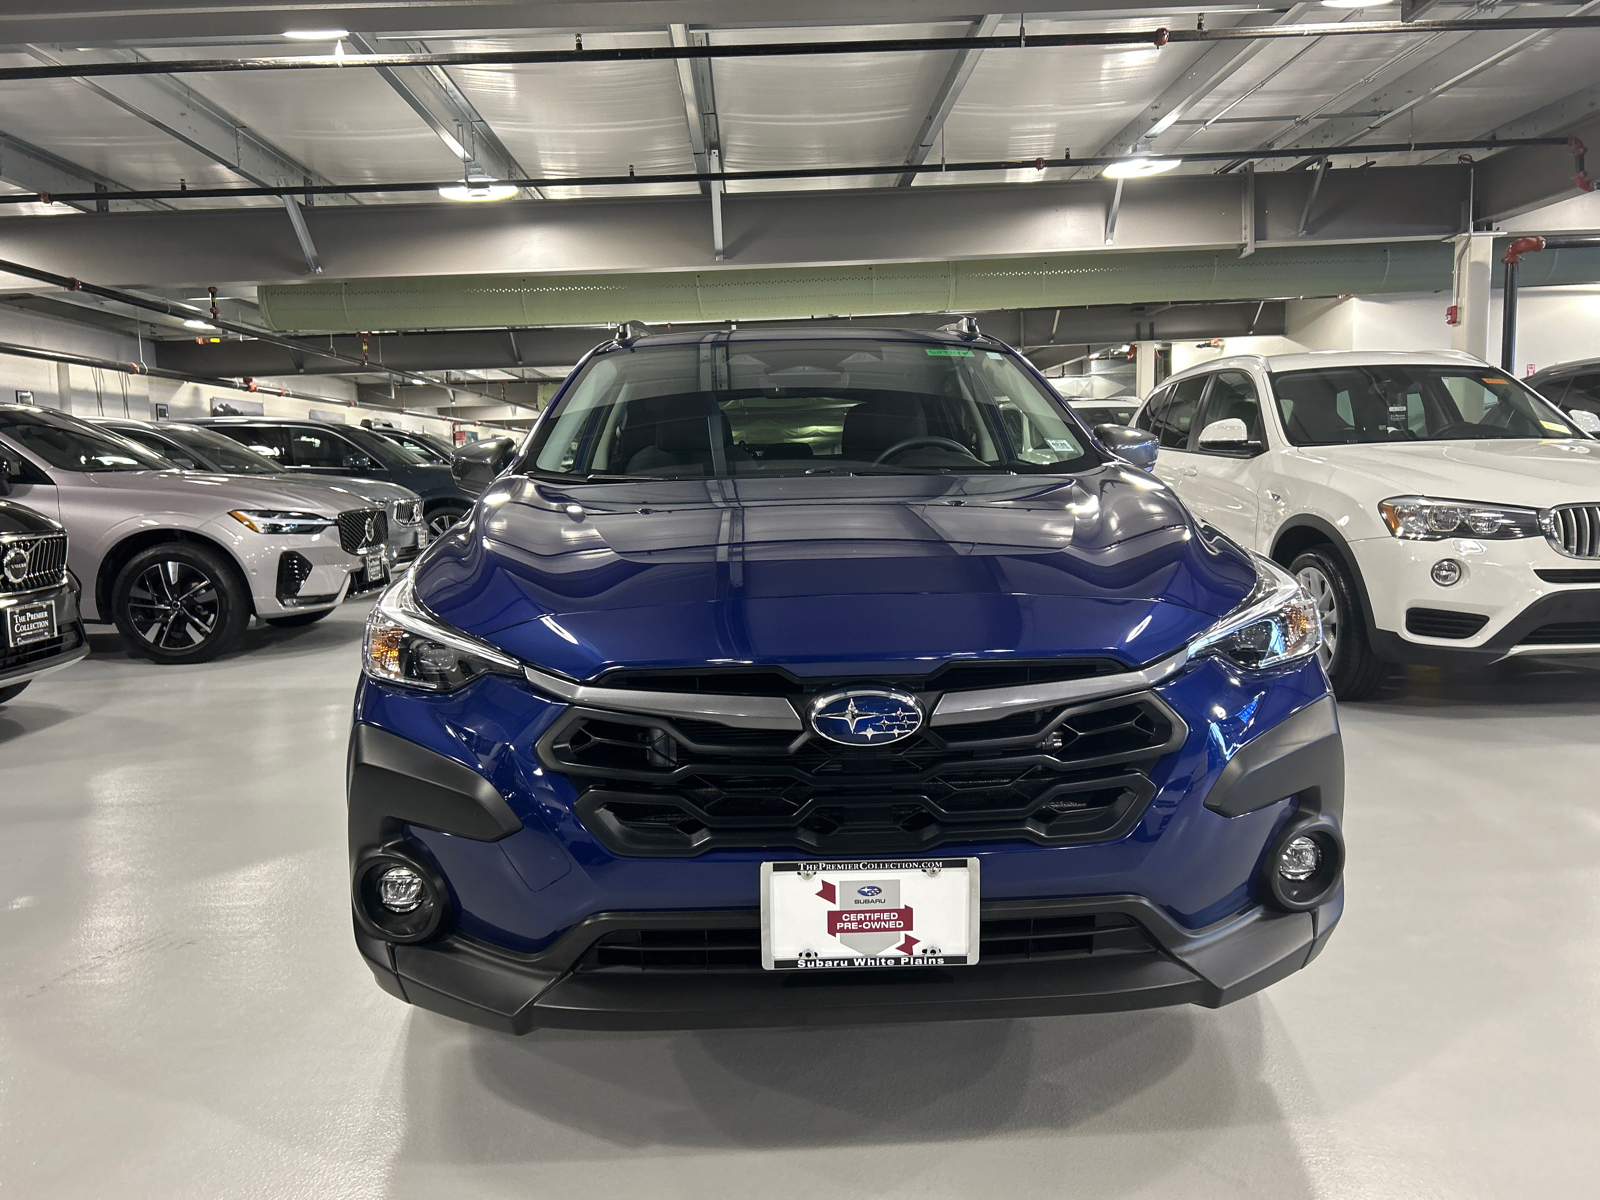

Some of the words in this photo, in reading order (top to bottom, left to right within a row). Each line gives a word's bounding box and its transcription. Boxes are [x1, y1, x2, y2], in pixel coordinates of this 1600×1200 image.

[842, 912, 898, 921] CERTIFIED
[836, 920, 904, 930] PRE-OWNED
[797, 959, 848, 968] Subaru
[853, 957, 895, 966] White
[900, 956, 944, 965] Plains
